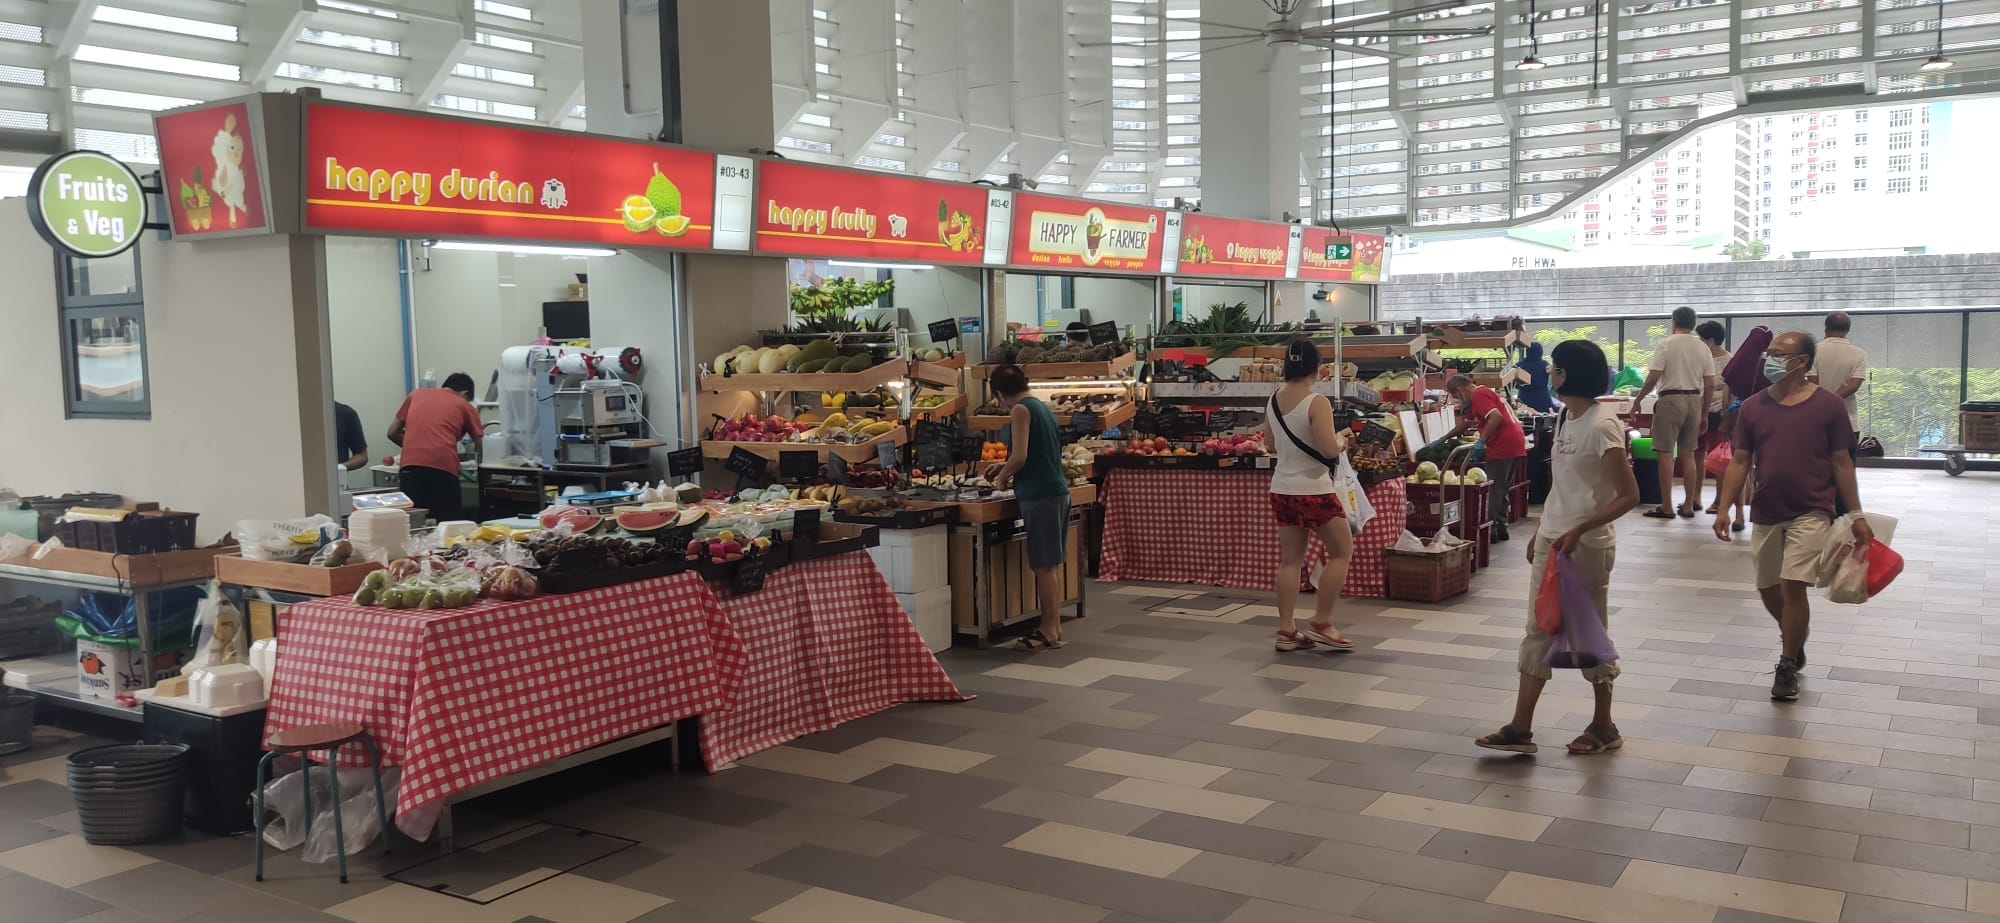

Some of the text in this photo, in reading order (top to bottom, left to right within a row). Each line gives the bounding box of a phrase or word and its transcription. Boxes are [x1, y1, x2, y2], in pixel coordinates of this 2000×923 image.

[58, 172, 130, 204] Fruits
[326, 156, 535, 207] happy durian
[719, 166, 751, 180] #03-43
[67, 209, 125, 244] & Veg
[768, 199, 878, 240] happy fruity
[1040, 221, 1147, 250] HAPPY FARMER
[1234, 243, 1260, 264] happy
[1511, 257, 1557, 268] PEI HWA
